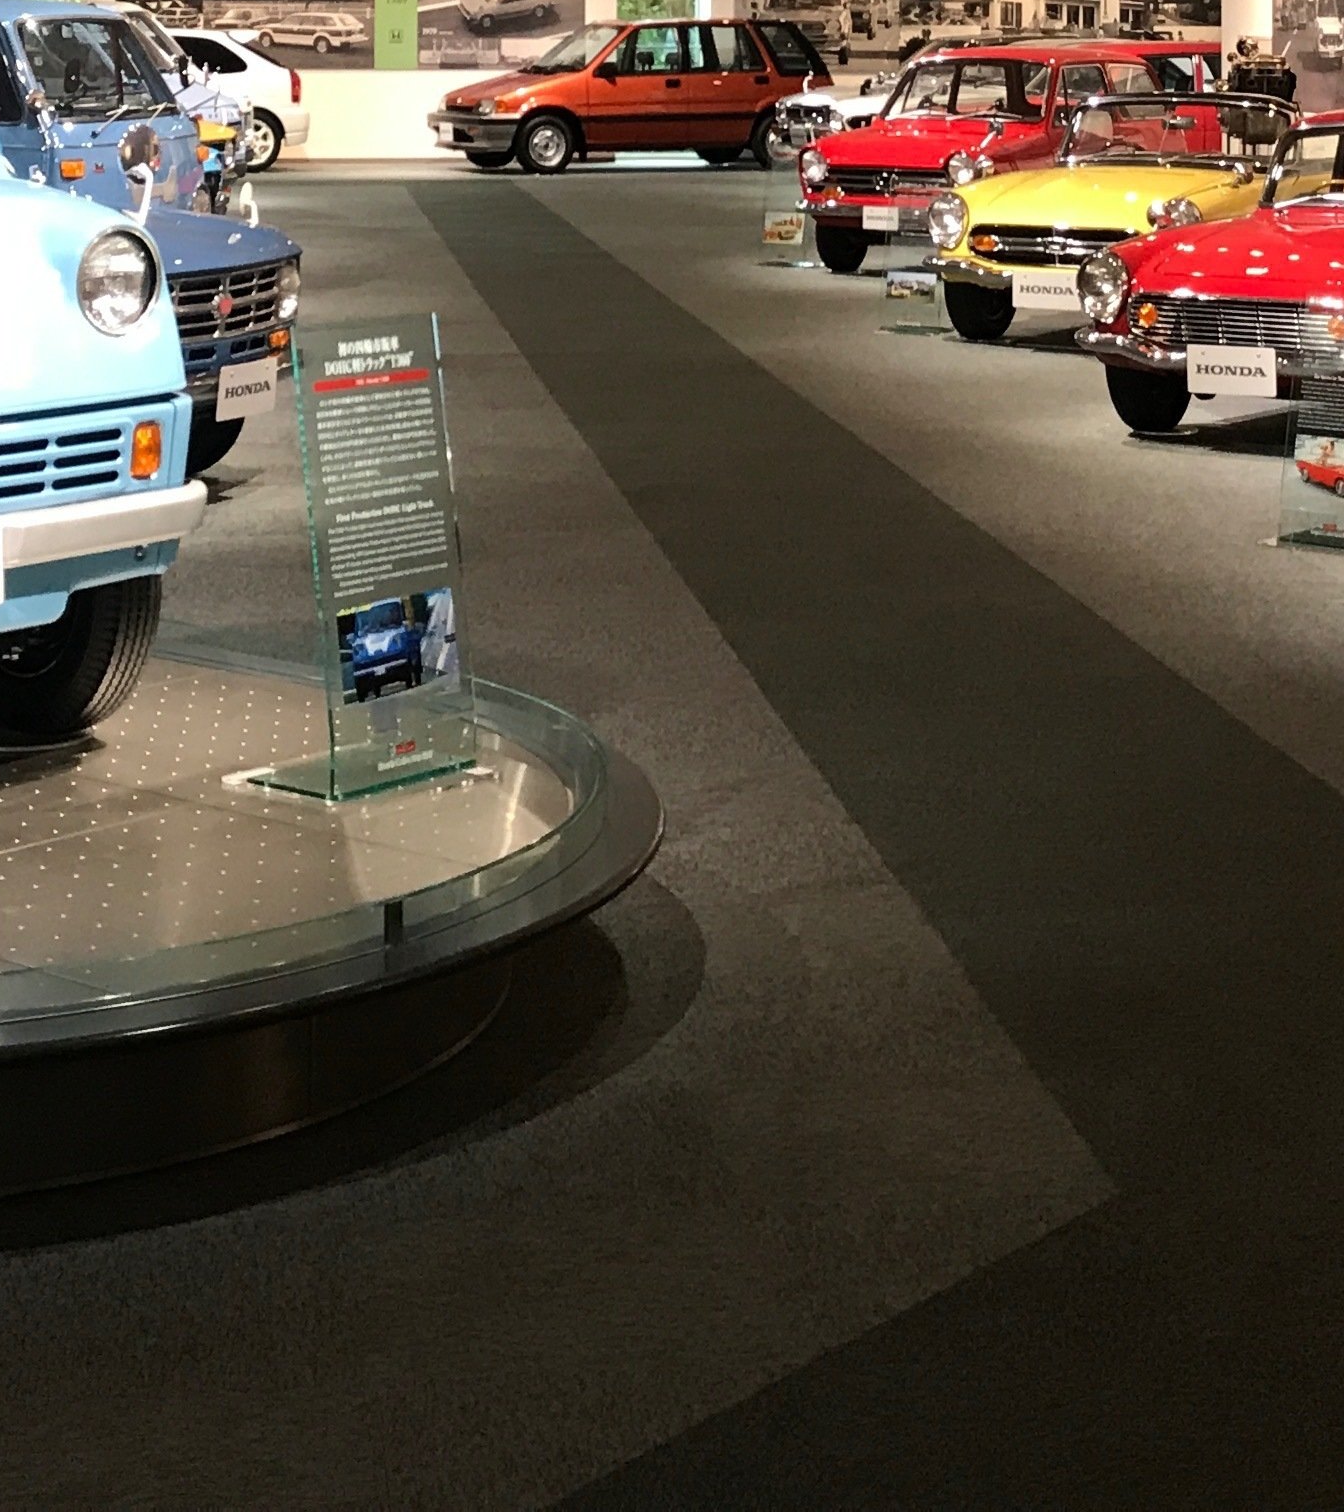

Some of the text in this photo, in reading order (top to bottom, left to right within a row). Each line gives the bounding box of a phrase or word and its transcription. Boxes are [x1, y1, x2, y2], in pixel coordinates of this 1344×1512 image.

[1019, 284, 1074, 297] HONDA
[1195, 363, 1267, 378] HONDA
[224, 379, 272, 400] HONDA
